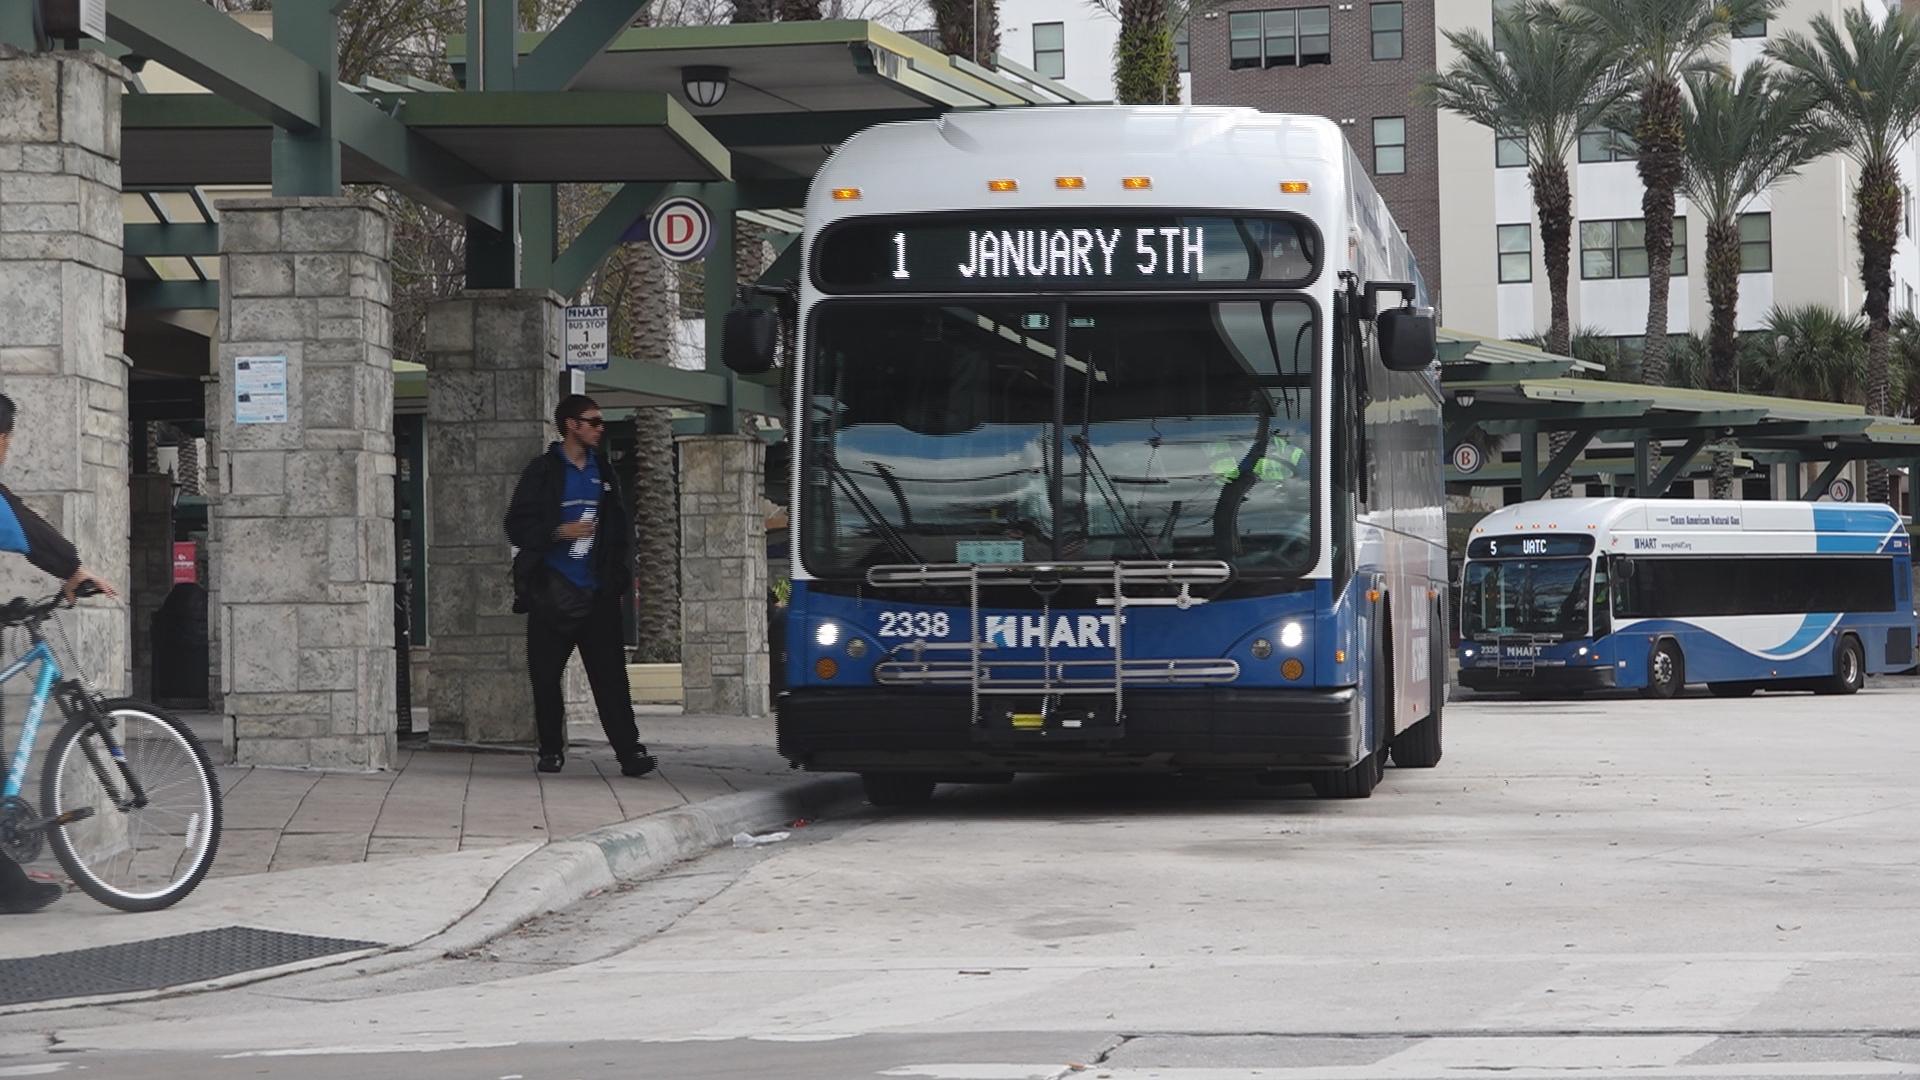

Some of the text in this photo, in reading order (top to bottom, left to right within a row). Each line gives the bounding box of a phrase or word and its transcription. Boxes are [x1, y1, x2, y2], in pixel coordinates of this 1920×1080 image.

[666, 213, 695, 244] D
[892, 226, 1205, 279] 1 JANUARY 5TH
[577, 308, 605, 317] HART
[569, 321, 606, 330] BUS STOP
[583, 330, 589, 342] 1
[568, 343, 589, 351] DROP
[577, 350, 597, 358] ONLY
[1461, 450, 1471, 466] B
[1834, 485, 1844, 497] A
[1670, 515, 1685, 525] Clean
[1686, 515, 1710, 525] American
[1711, 516, 1729, 525] Natural
[1730, 516, 1740, 525] Gas
[1490, 539, 1547, 555] 5 UATC
[1640, 538, 1657, 549] HART
[878, 611, 950, 637] 2338
[1021, 615, 1127, 648] HART
